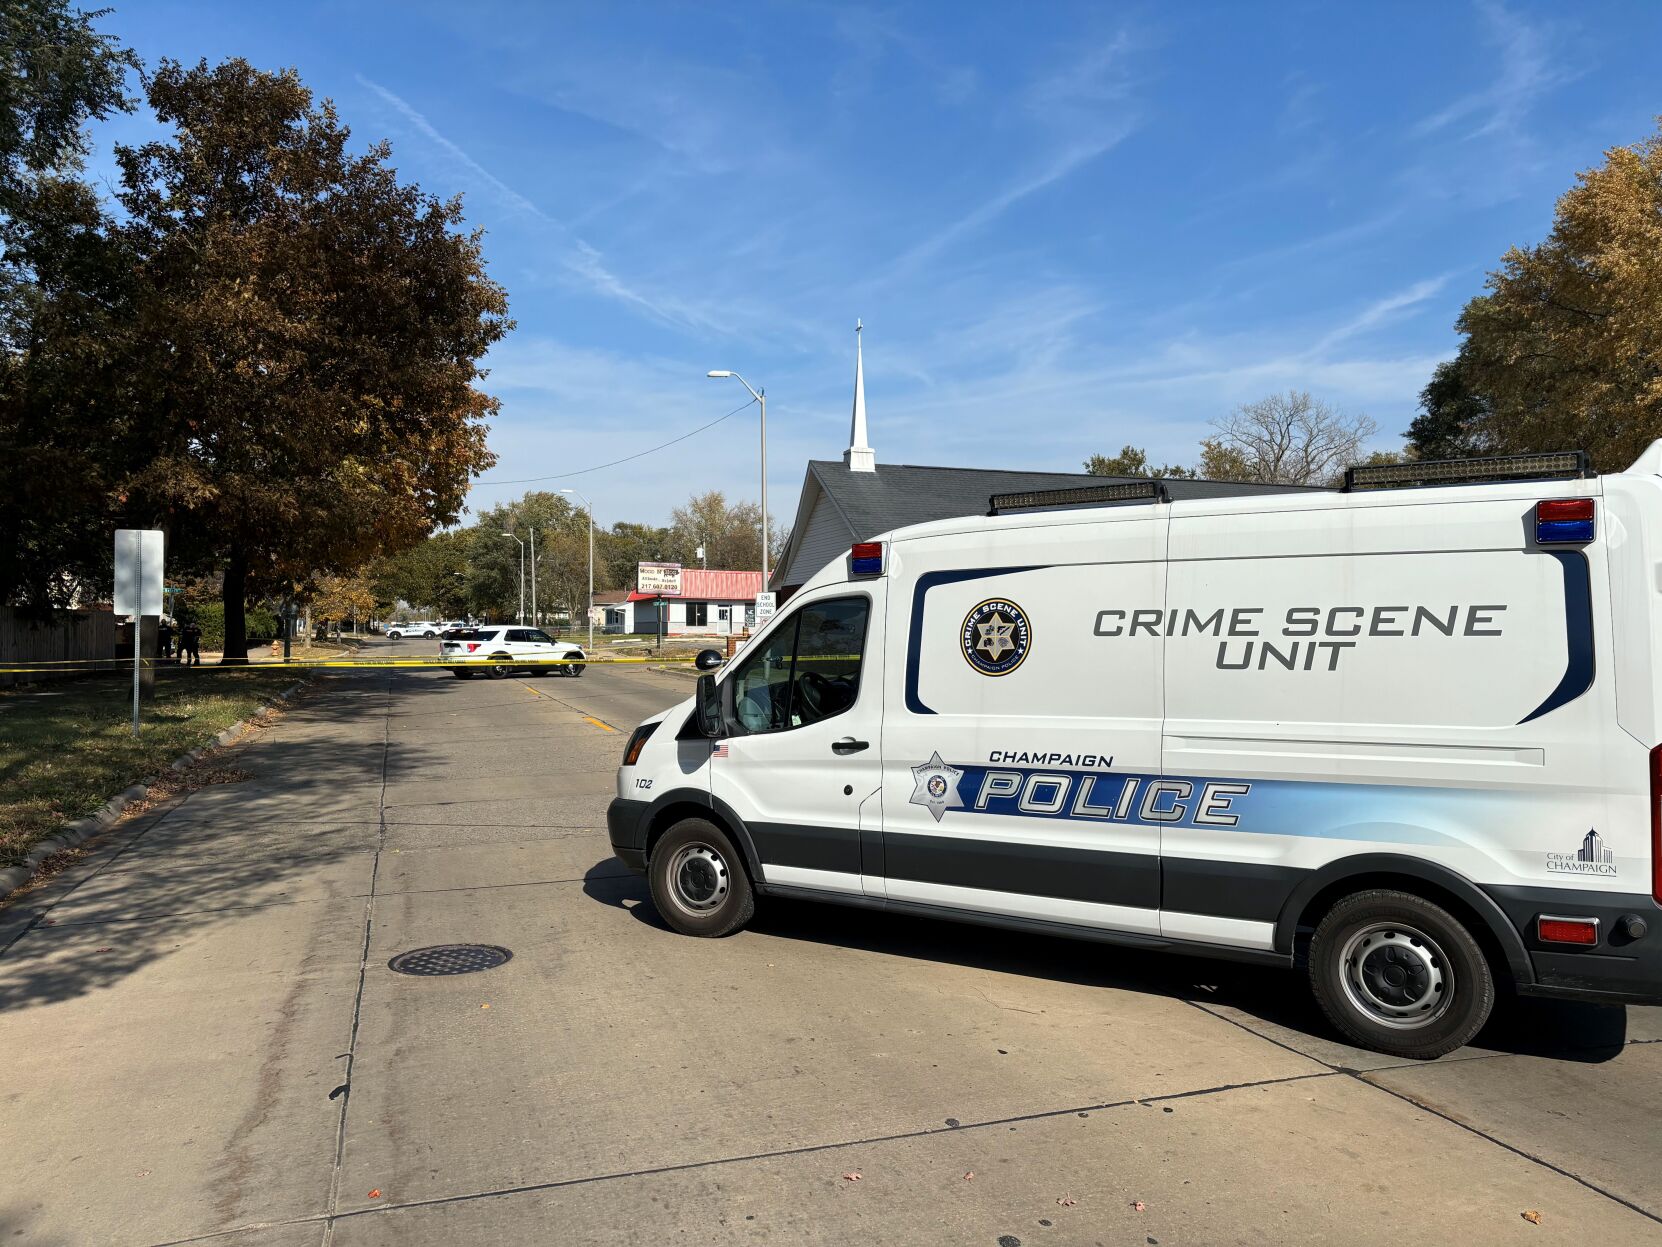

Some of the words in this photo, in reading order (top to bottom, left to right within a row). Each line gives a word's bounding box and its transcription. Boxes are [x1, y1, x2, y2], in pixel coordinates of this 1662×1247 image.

[964, 611, 981, 647] CRIME
[982, 603, 1018, 618] SCENE
[1016, 618, 1027, 647] UNIT
[1093, 607, 1264, 637] CRIME
[1281, 604, 1508, 637] SCENE
[971, 654, 1000, 671] CHAMPAIGN
[1001, 654, 1019, 669] POLICE
[1215, 641, 1356, 671] UNIT
[989, 750, 1114, 768] CHAMPAIGN
[635, 778, 653, 789] 102
[974, 770, 1252, 826] POLICE
[1546, 852, 1564, 861] City
[1565, 853, 1575, 861] of
[1546, 860, 1617, 874] CHAMPAIGN
